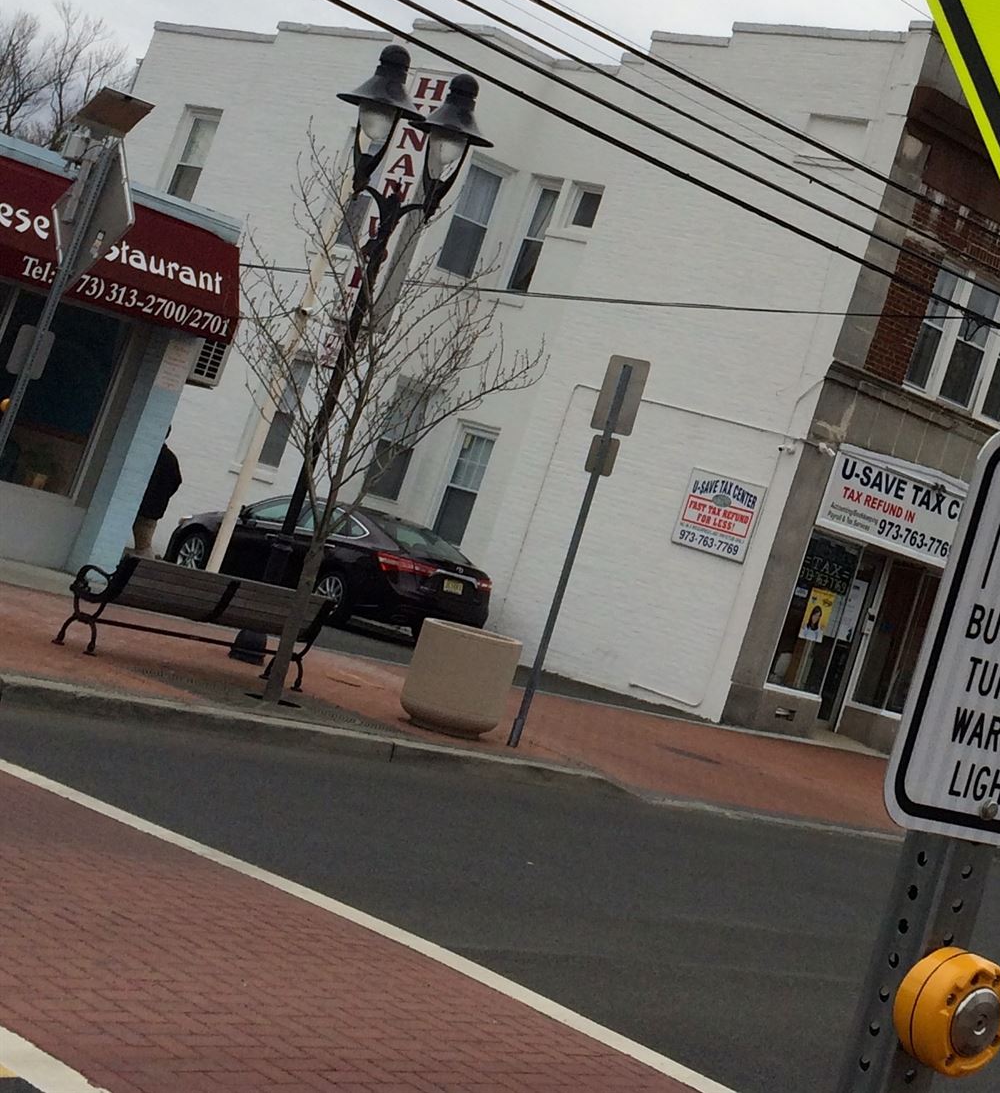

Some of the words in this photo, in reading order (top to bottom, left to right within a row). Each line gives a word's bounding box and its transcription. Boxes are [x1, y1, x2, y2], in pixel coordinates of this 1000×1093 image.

[21, 255, 57, 284] Tel:
[105, 282, 231, 337] 313-2700/2701
[692, 479, 720, 495] U-SAVE
[719, 480, 734, 497] TAX
[732, 484, 758, 509] CENTER
[842, 457, 908, 500] U-SAVE
[911, 484, 947, 515] TAX
[688, 500, 707, 512] FAST
[708, 505, 722, 518] TAX
[722, 508, 750, 524] REFUND
[696, 513, 712, 523] FOR
[842, 486, 862, 504] TAX
[863, 494, 904, 519] REFUND
[903, 511, 917, 524] IN
[678, 529, 739, 556] 973-763-7769
[877, 518, 951, 558] 973-763-776
